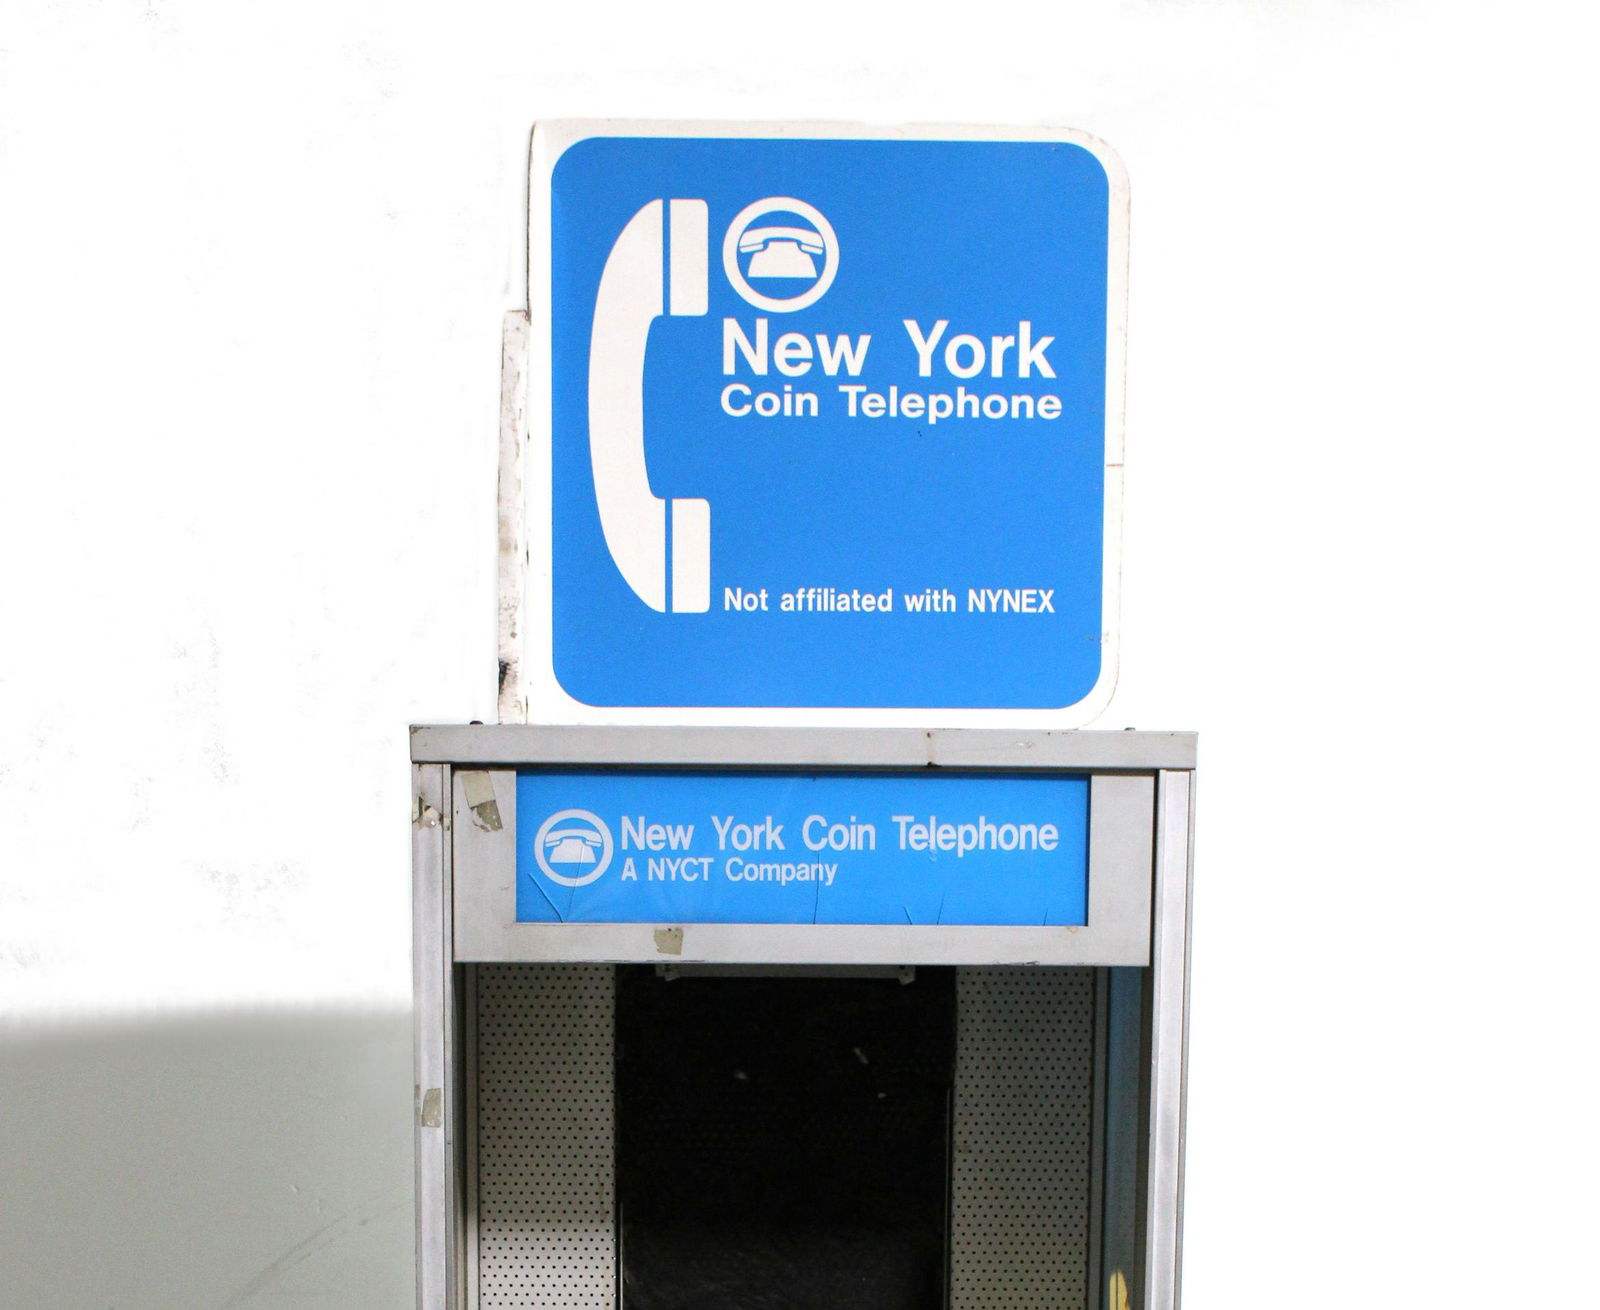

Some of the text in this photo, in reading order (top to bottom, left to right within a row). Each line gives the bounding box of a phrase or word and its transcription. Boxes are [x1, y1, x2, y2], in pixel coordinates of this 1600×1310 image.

[722, 317, 1056, 379] New York
[721, 383, 1062, 425] Coin Telephone
[724, 586, 1055, 613] Not affiliated with NYNEX
[621, 814, 1058, 858] New York Coin Telephone
[621, 857, 837, 886] A NYCT Company
